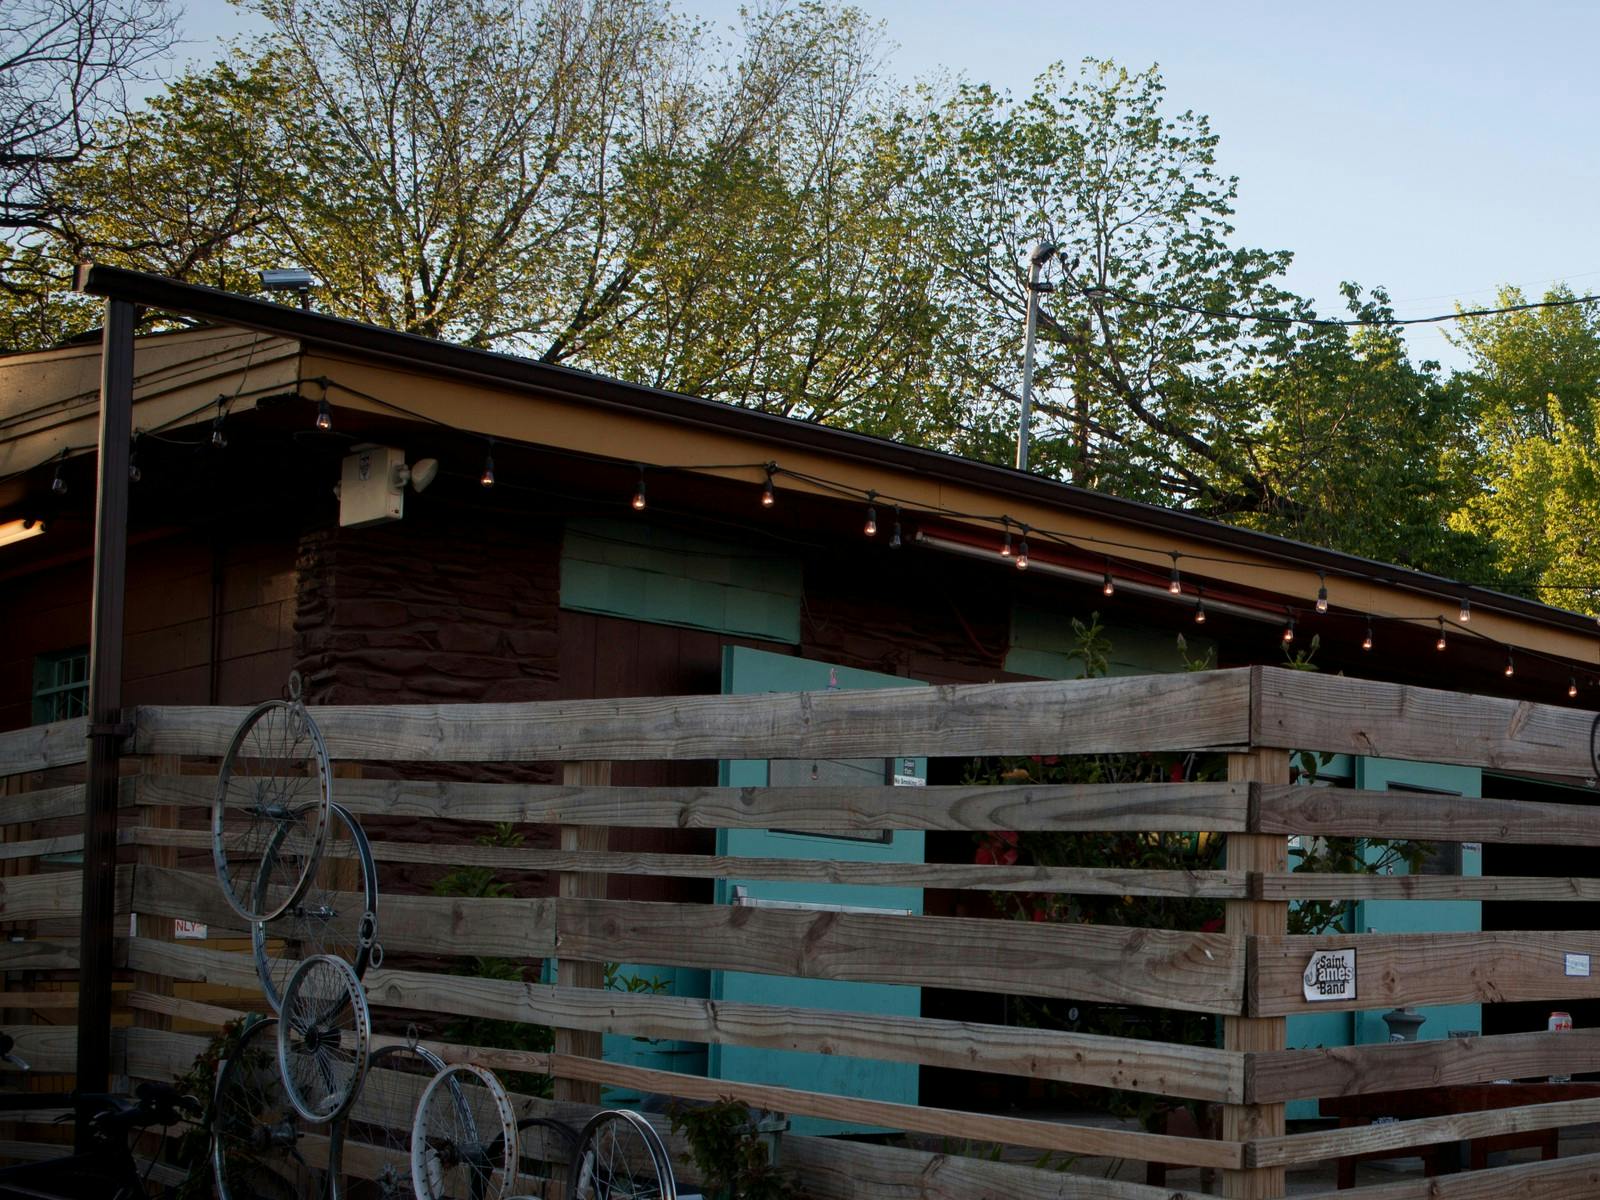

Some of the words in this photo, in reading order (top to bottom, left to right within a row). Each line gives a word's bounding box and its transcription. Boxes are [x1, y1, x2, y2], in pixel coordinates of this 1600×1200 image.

[176, 921, 196, 932] NLY
[1320, 954, 1346, 968] Saint
[1304, 959, 1354, 987] James
[1320, 981, 1345, 994] Band
